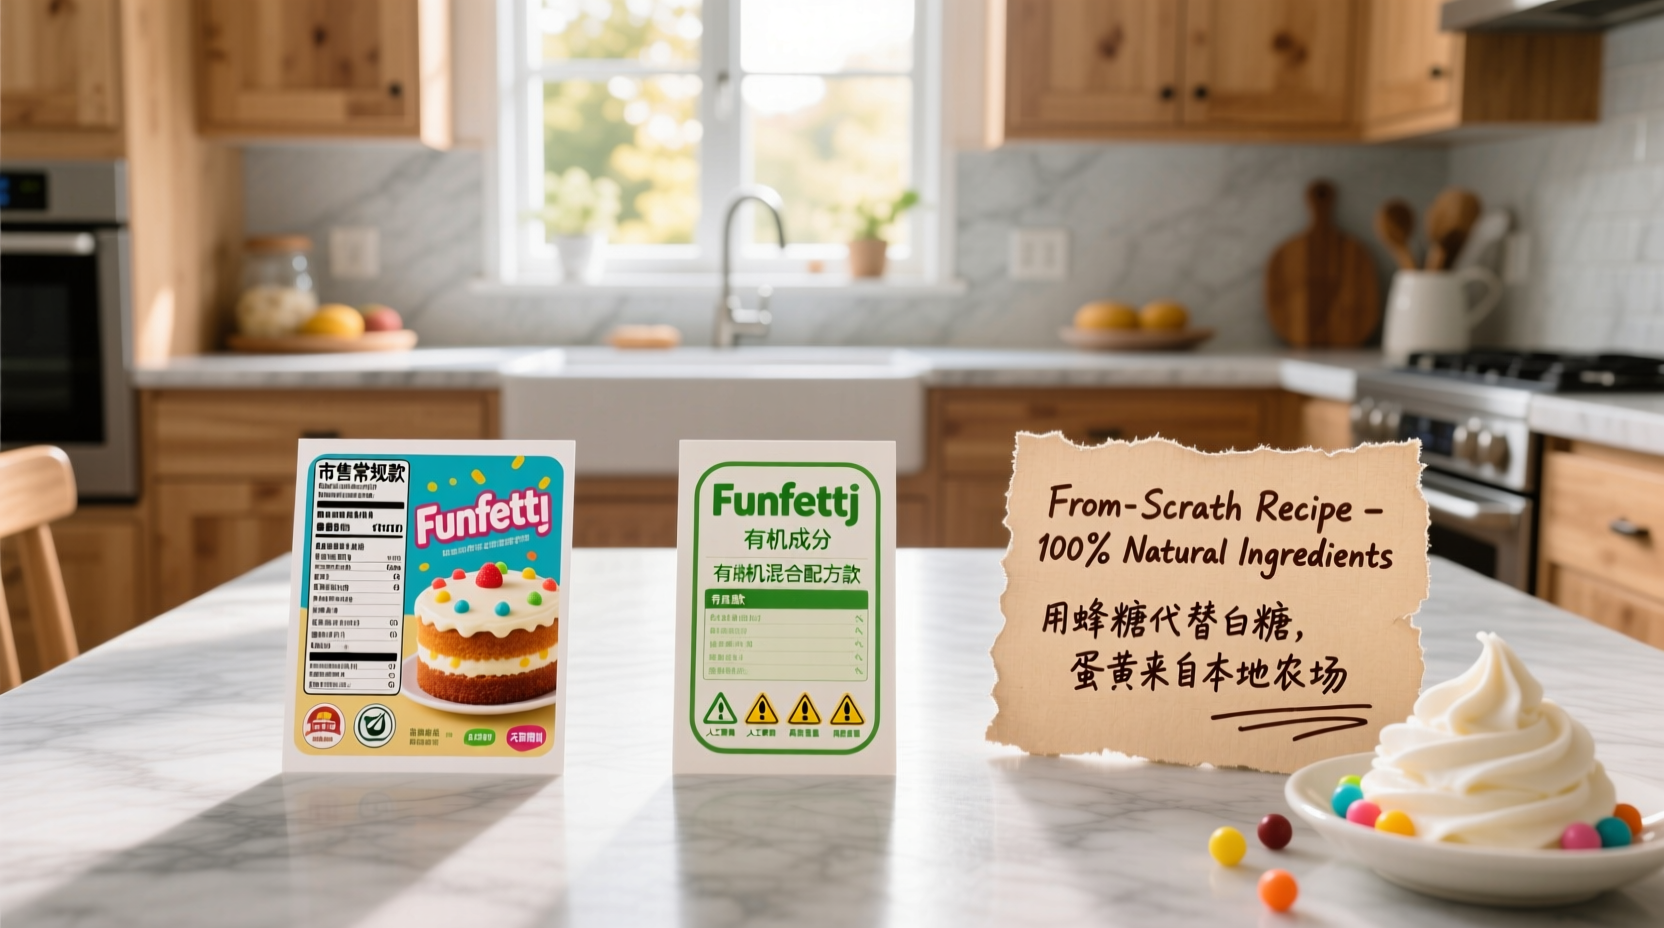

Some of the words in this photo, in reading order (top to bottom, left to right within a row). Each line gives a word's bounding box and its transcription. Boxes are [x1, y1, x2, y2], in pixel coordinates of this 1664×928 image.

[318, 461, 407, 483] 市售常规款
[1048, 484, 1242, 522] From-Scrath
[1255, 489, 1352, 534] Recipe
[744, 527, 832, 551] 有机成分
[1038, 531, 1111, 568] 100%
[1122, 535, 1227, 565] Natural
[1238, 536, 1393, 580] Ingredients
[1042, 597, 1303, 643] 用蜂糖代替白糖，
[1070, 649, 1348, 695] 蛋黄来自本地农场
